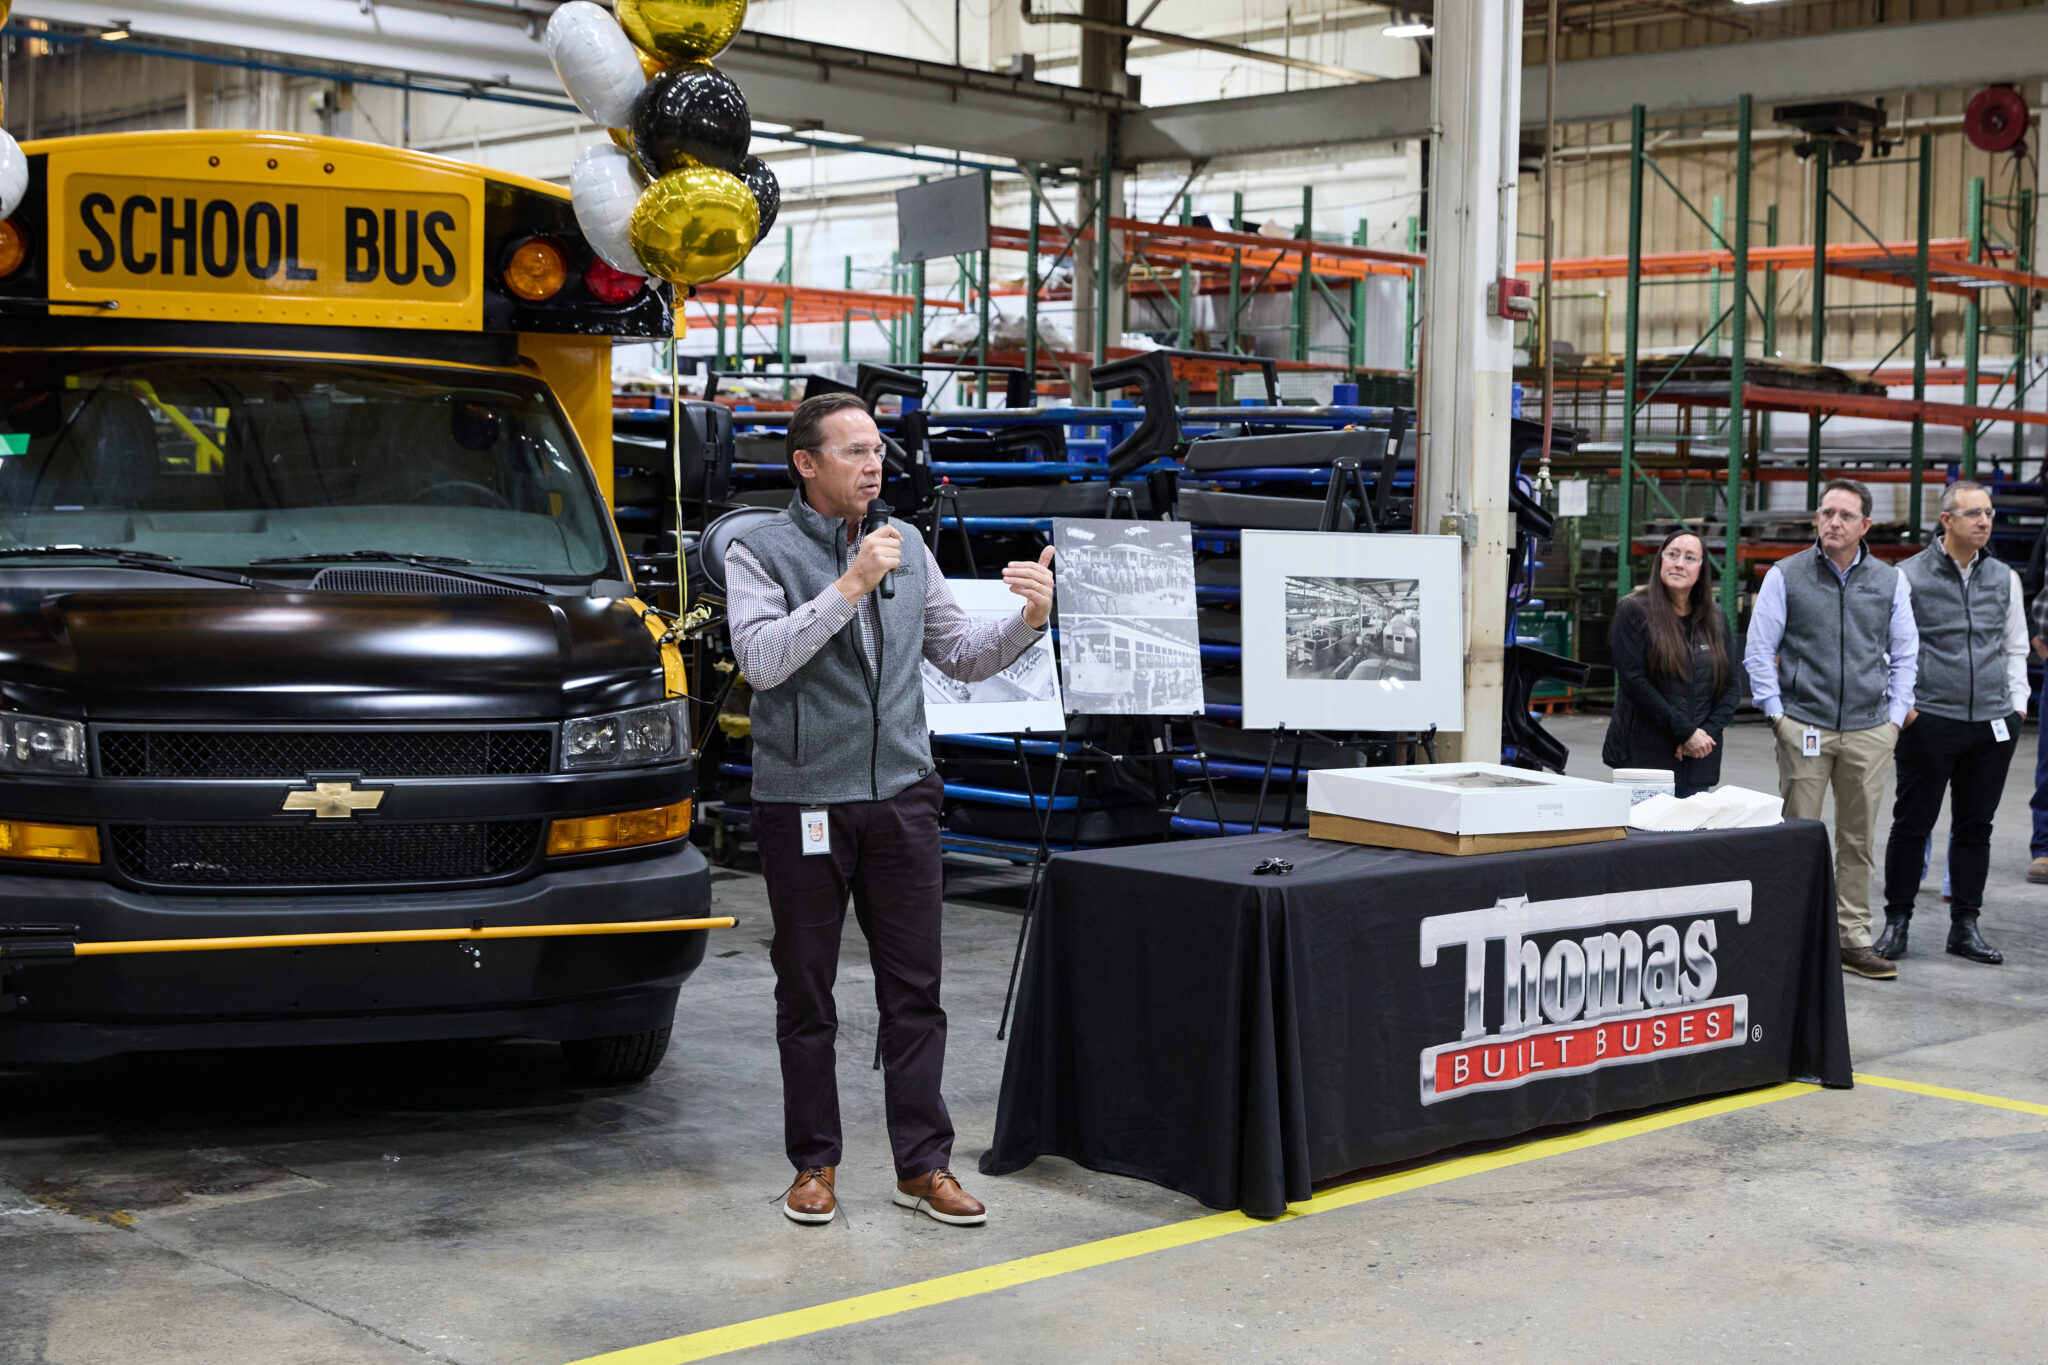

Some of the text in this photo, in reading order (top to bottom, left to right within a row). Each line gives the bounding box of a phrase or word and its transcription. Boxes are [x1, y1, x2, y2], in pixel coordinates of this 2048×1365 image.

[78, 193, 457, 288] SCHOOL BUS
[1420, 879, 1752, 1041] Thomas
[1454, 1036, 1574, 1084] BUILT
[1596, 1011, 1721, 1057] BUSES
